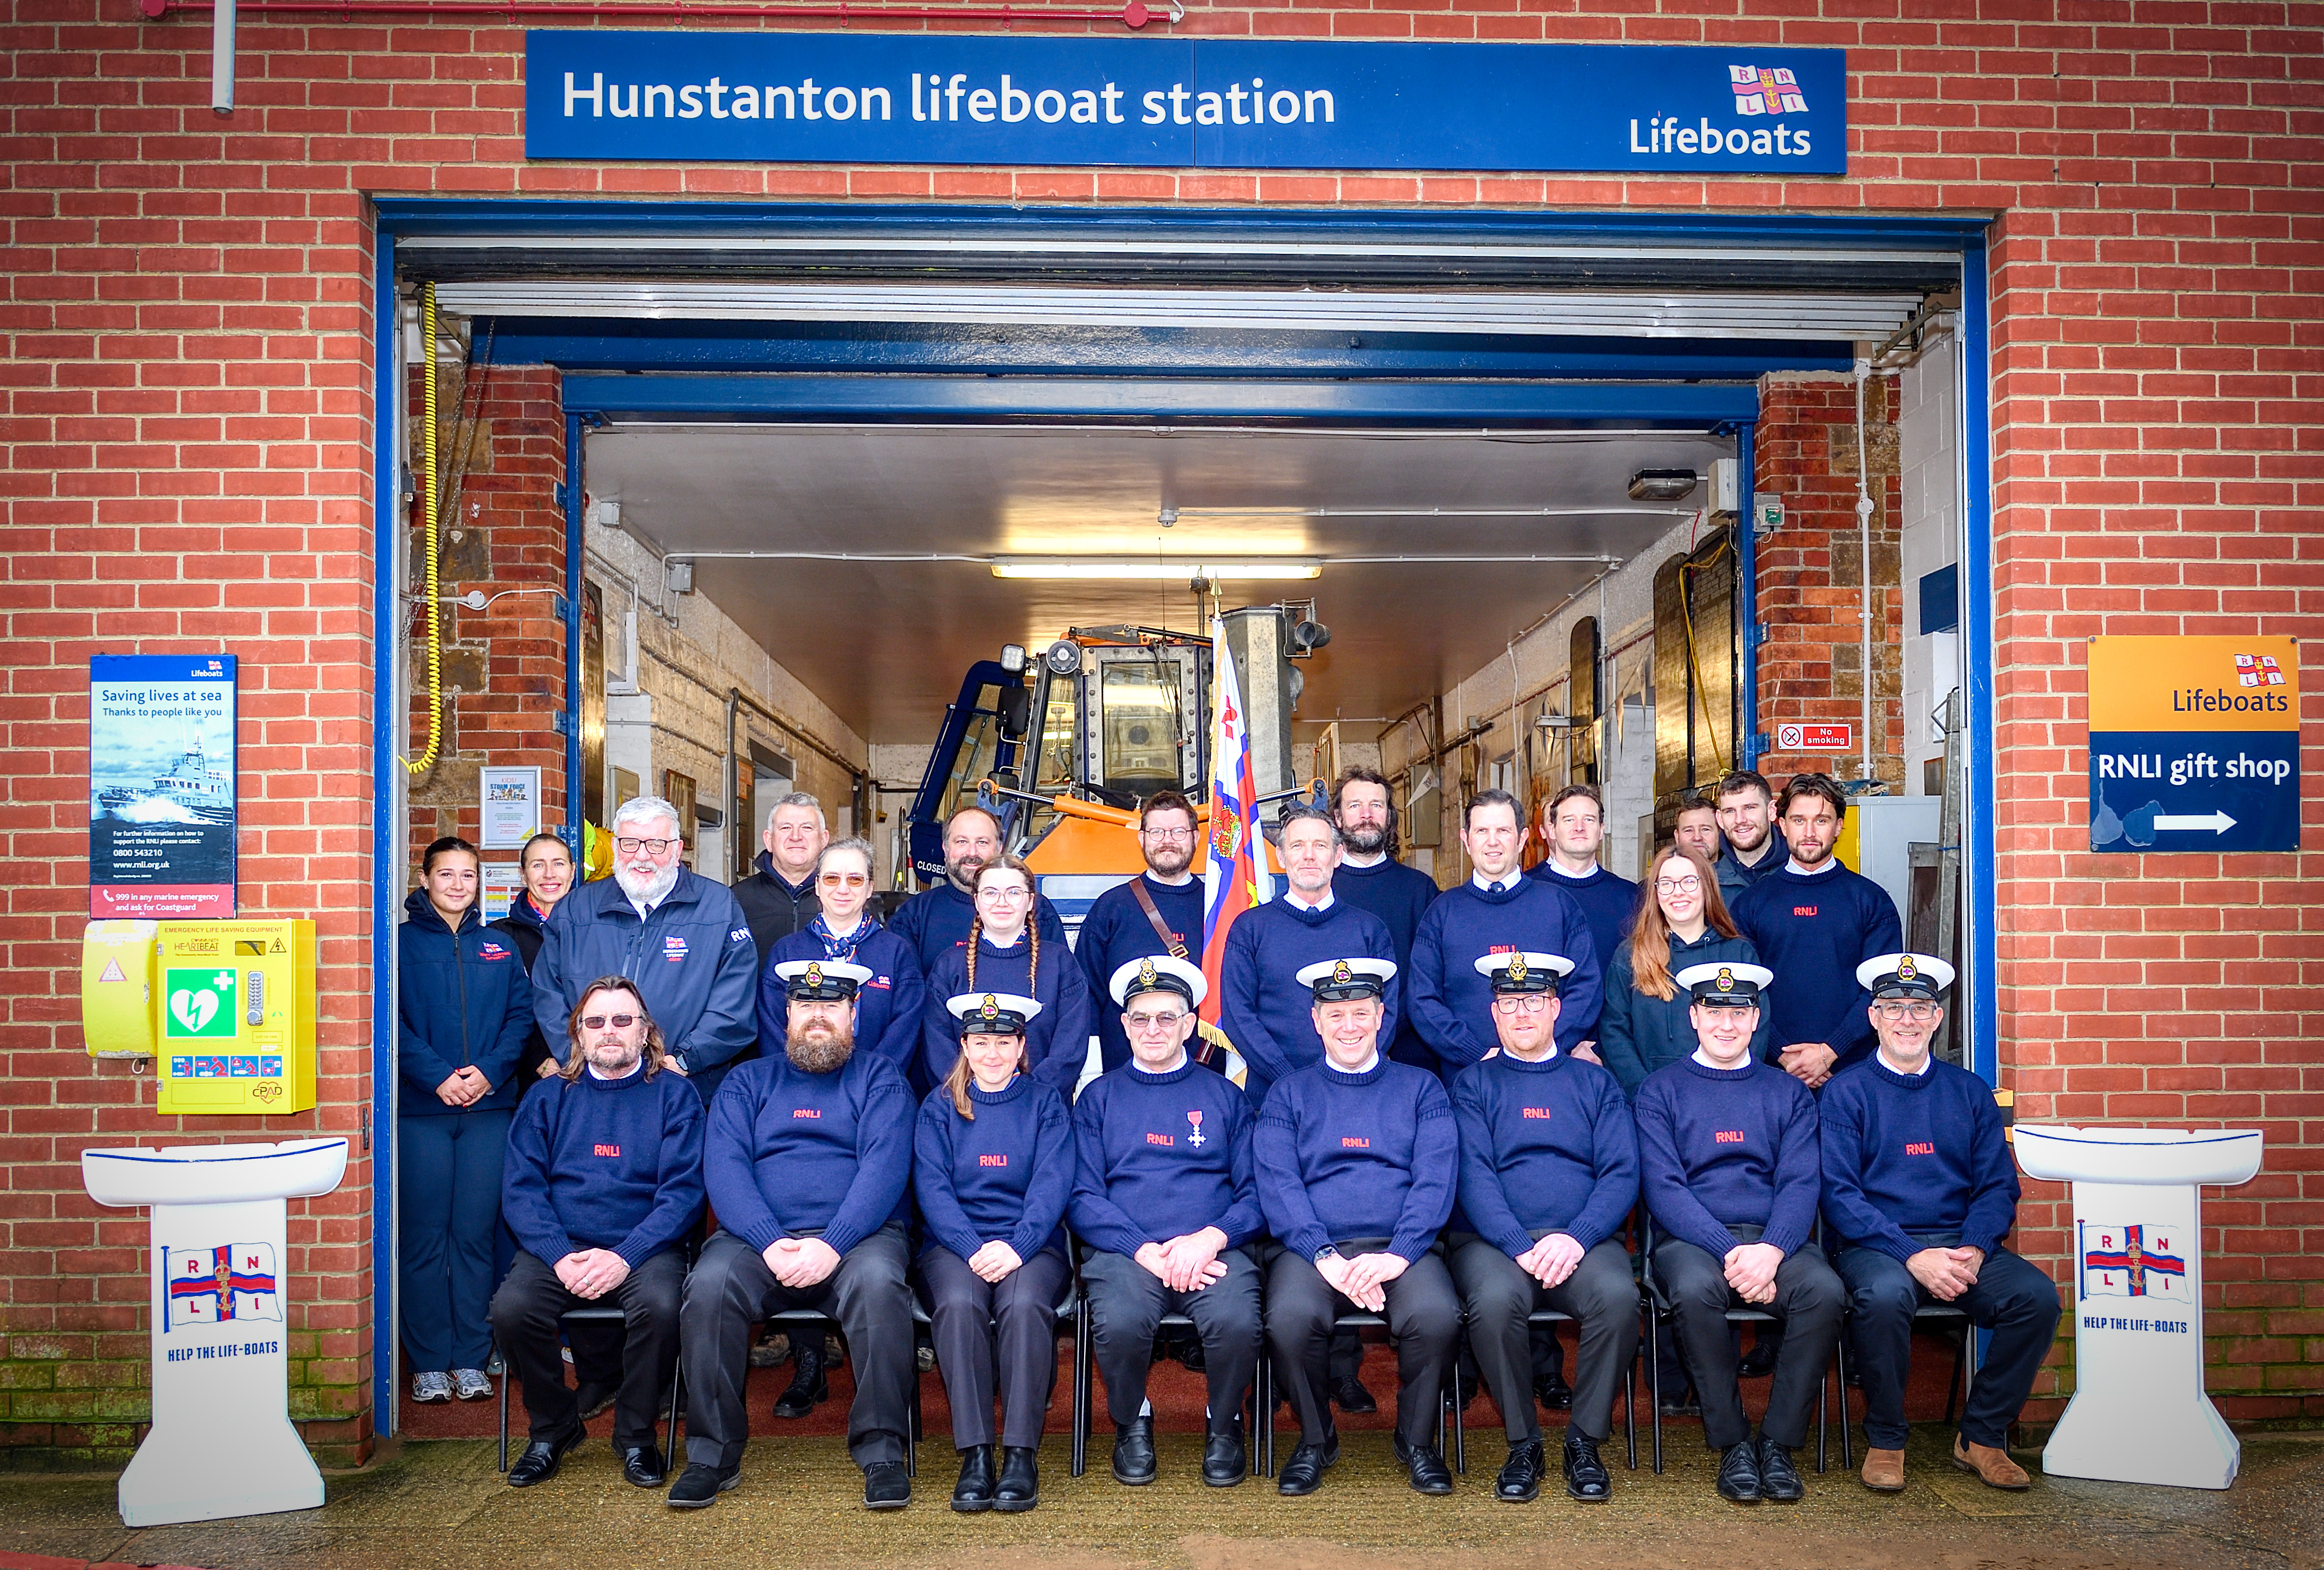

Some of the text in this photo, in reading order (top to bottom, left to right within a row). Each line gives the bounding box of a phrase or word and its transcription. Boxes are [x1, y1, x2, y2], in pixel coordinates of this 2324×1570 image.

[1738, 68, 1790, 82] R N
[562, 71, 1334, 125] Hunstanton lifeboat station
[1746, 97, 1797, 112] L I
[1630, 117, 1811, 155] Lifeboats
[103, 690, 222, 704] Saving lives at sea
[2174, 689, 2287, 711] Lifeboats
[152, 708, 182, 718] people
[205, 709, 222, 718] you
[1807, 736, 1845, 745] smoking
[2099, 753, 2290, 785] RNLI gift shop
[113, 861, 170, 869] www.rnli.org.uk
[917, 860, 946, 875] CLOSED
[156, 904, 196, 913] Coastguard
[1794, 906, 1817, 916] RNLI
[253, 1087, 282, 1098] CPAD
[793, 1109, 821, 1119] RNLI
[1522, 1107, 1550, 1119] RNLI
[1146, 1133, 1174, 1146] RNLI
[1342, 1137, 1370, 1148] RNLI
[1715, 1131, 1745, 1143] RNLI
[594, 1145, 620, 1157] RNLI
[1906, 1142, 1934, 1156] RNLI
[979, 1155, 1007, 1167] RNLI
[2102, 1236, 2168, 1250] R N
[188, 1256, 258, 1273] R N
[2104, 1274, 2169, 1290] L I
[191, 1298, 259, 1313] L I
[2084, 1317, 2187, 1333] HELP THE LIFE-BOATS
[169, 1342, 277, 1361] HELP THE LIFE-BOATS
